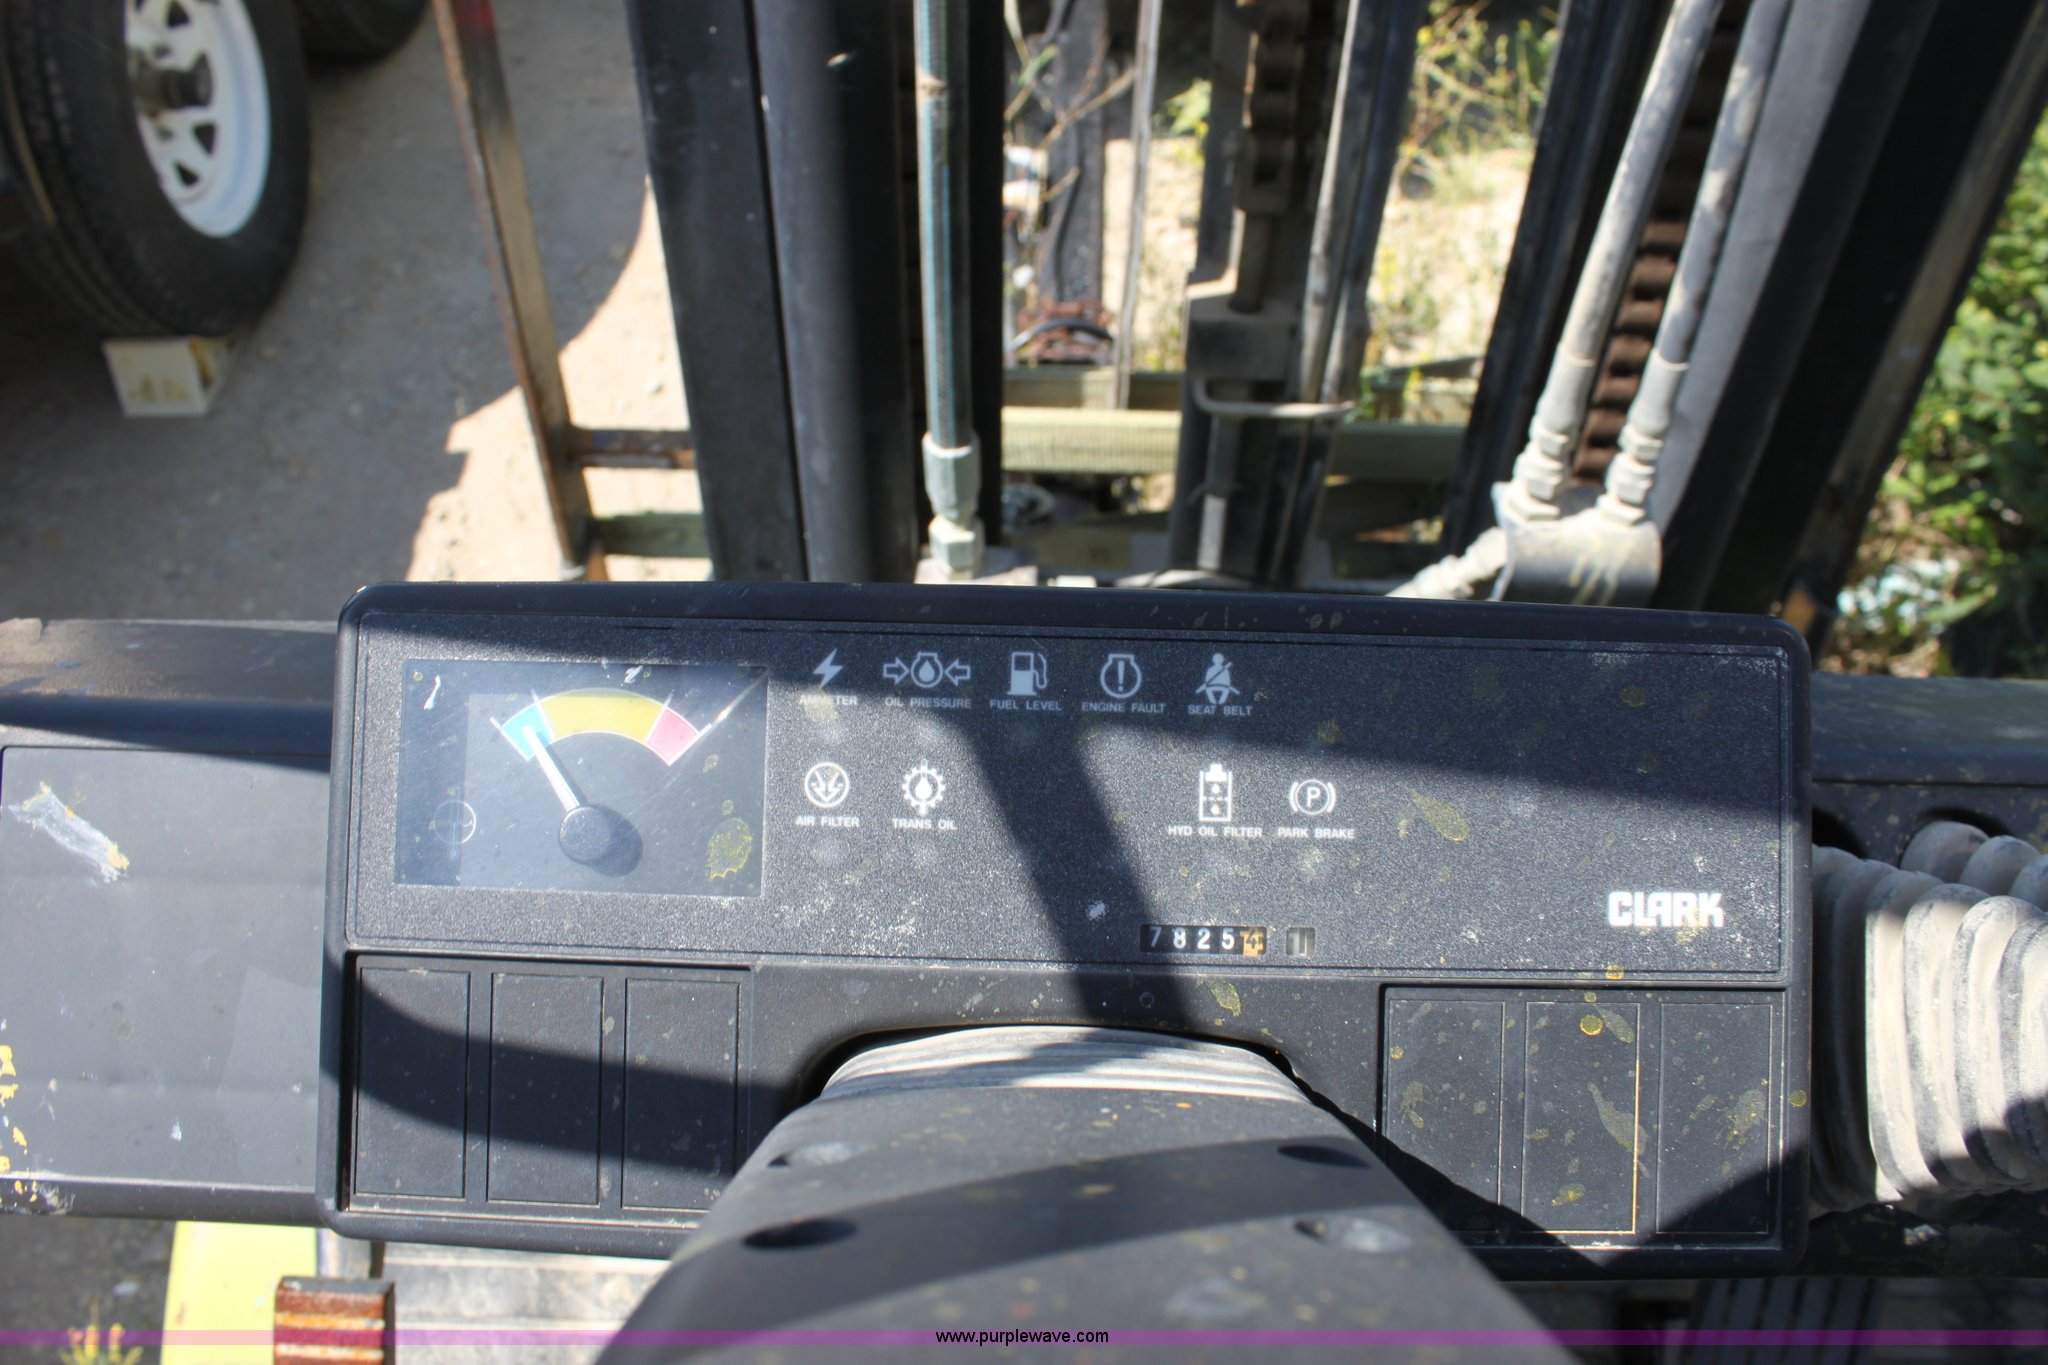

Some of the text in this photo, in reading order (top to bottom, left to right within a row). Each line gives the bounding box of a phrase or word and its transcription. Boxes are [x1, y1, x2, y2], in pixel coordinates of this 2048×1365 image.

[885, 695, 972, 709] OIL PRESSURE
[990, 700, 1063, 712] FUEL LEVEL
[1082, 702, 1167, 714] ENGINE FAULT
[1188, 704, 1254, 717] SEAT BELT
[1306, 787, 1321, 808] P
[795, 815, 860, 828] AIR FILTER
[892, 817, 957, 830] TRANS OIL
[1168, 825, 1263, 838] HYD OIL FILTER
[1278, 827, 1356, 840] PARK BRAKE
[1608, 891, 1725, 928] CLARK
